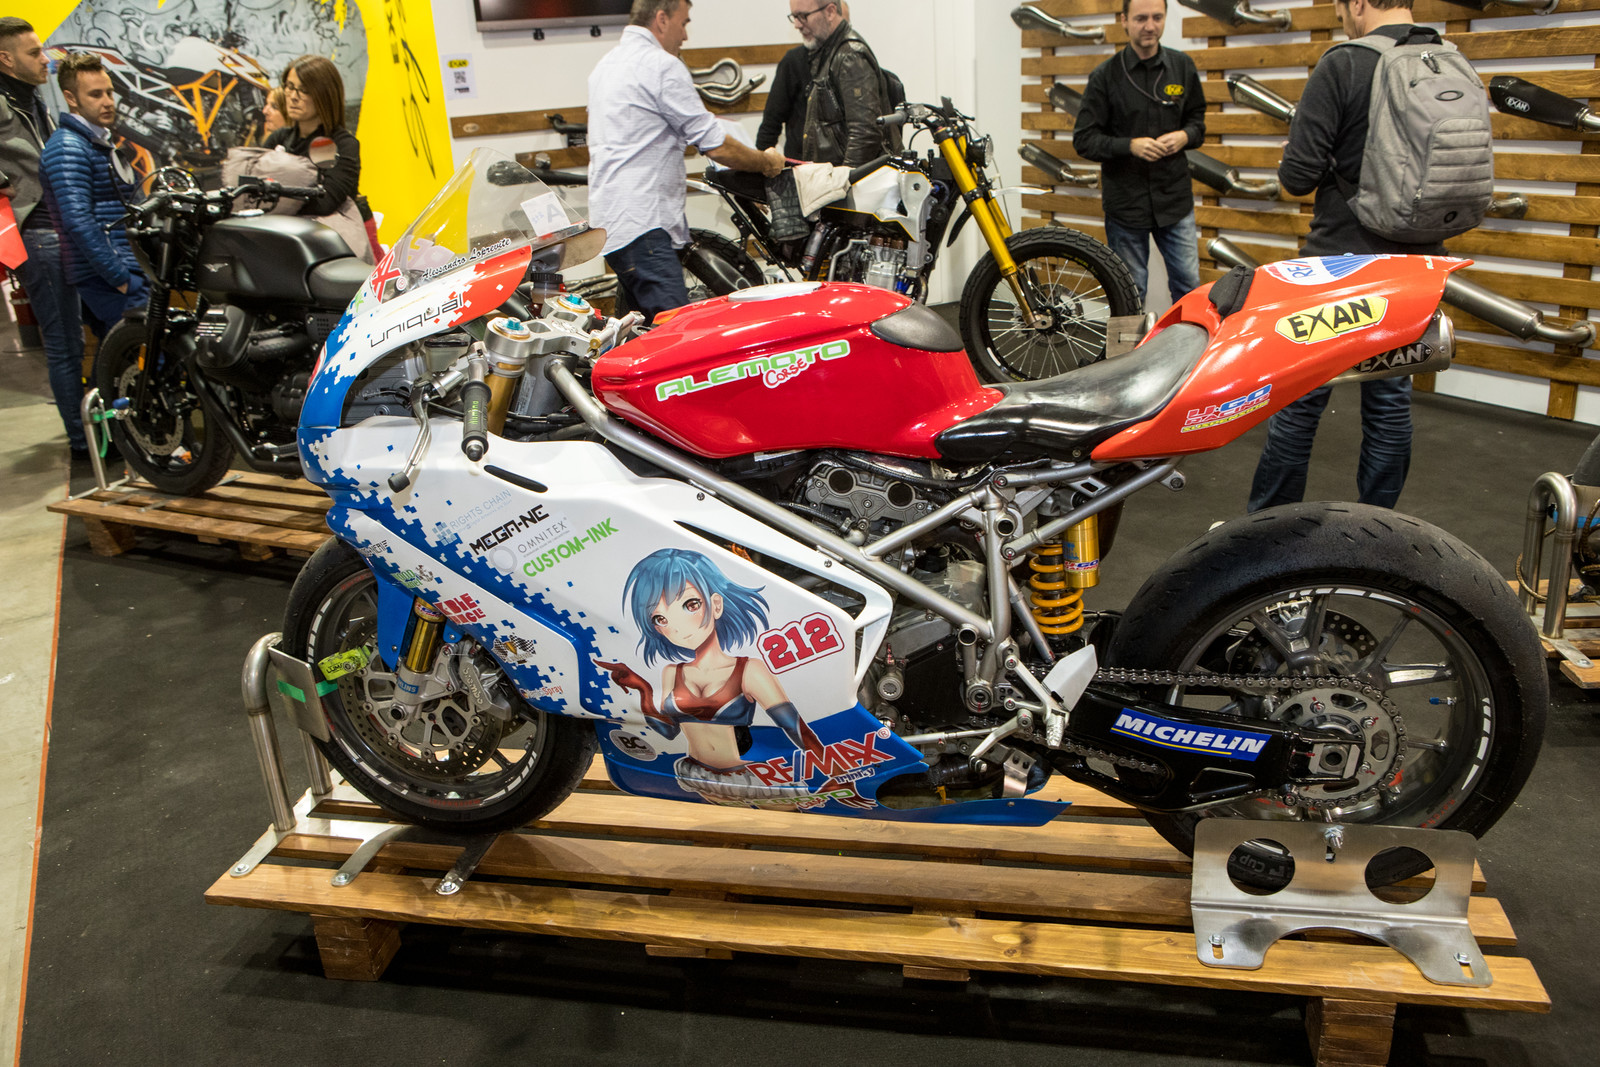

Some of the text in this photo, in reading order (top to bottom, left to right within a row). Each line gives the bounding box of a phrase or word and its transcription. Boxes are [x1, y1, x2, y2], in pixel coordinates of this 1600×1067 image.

[1507, 96, 1528, 111] EXAN
[1287, 298, 1373, 340] EXAN
[657, 341, 849, 399] ALEMOTO
[1360, 343, 1422, 372] EXAN
[450, 507, 482, 531] RIGHTS
[483, 489, 512, 511] CHAIN
[517, 520, 567, 554] OMNITEX
[523, 517, 620, 577] CUSTOM-INK
[762, 618, 840, 669] 212
[618, 737, 647, 749] BC
[1115, 714, 1266, 753] MICHELIN
